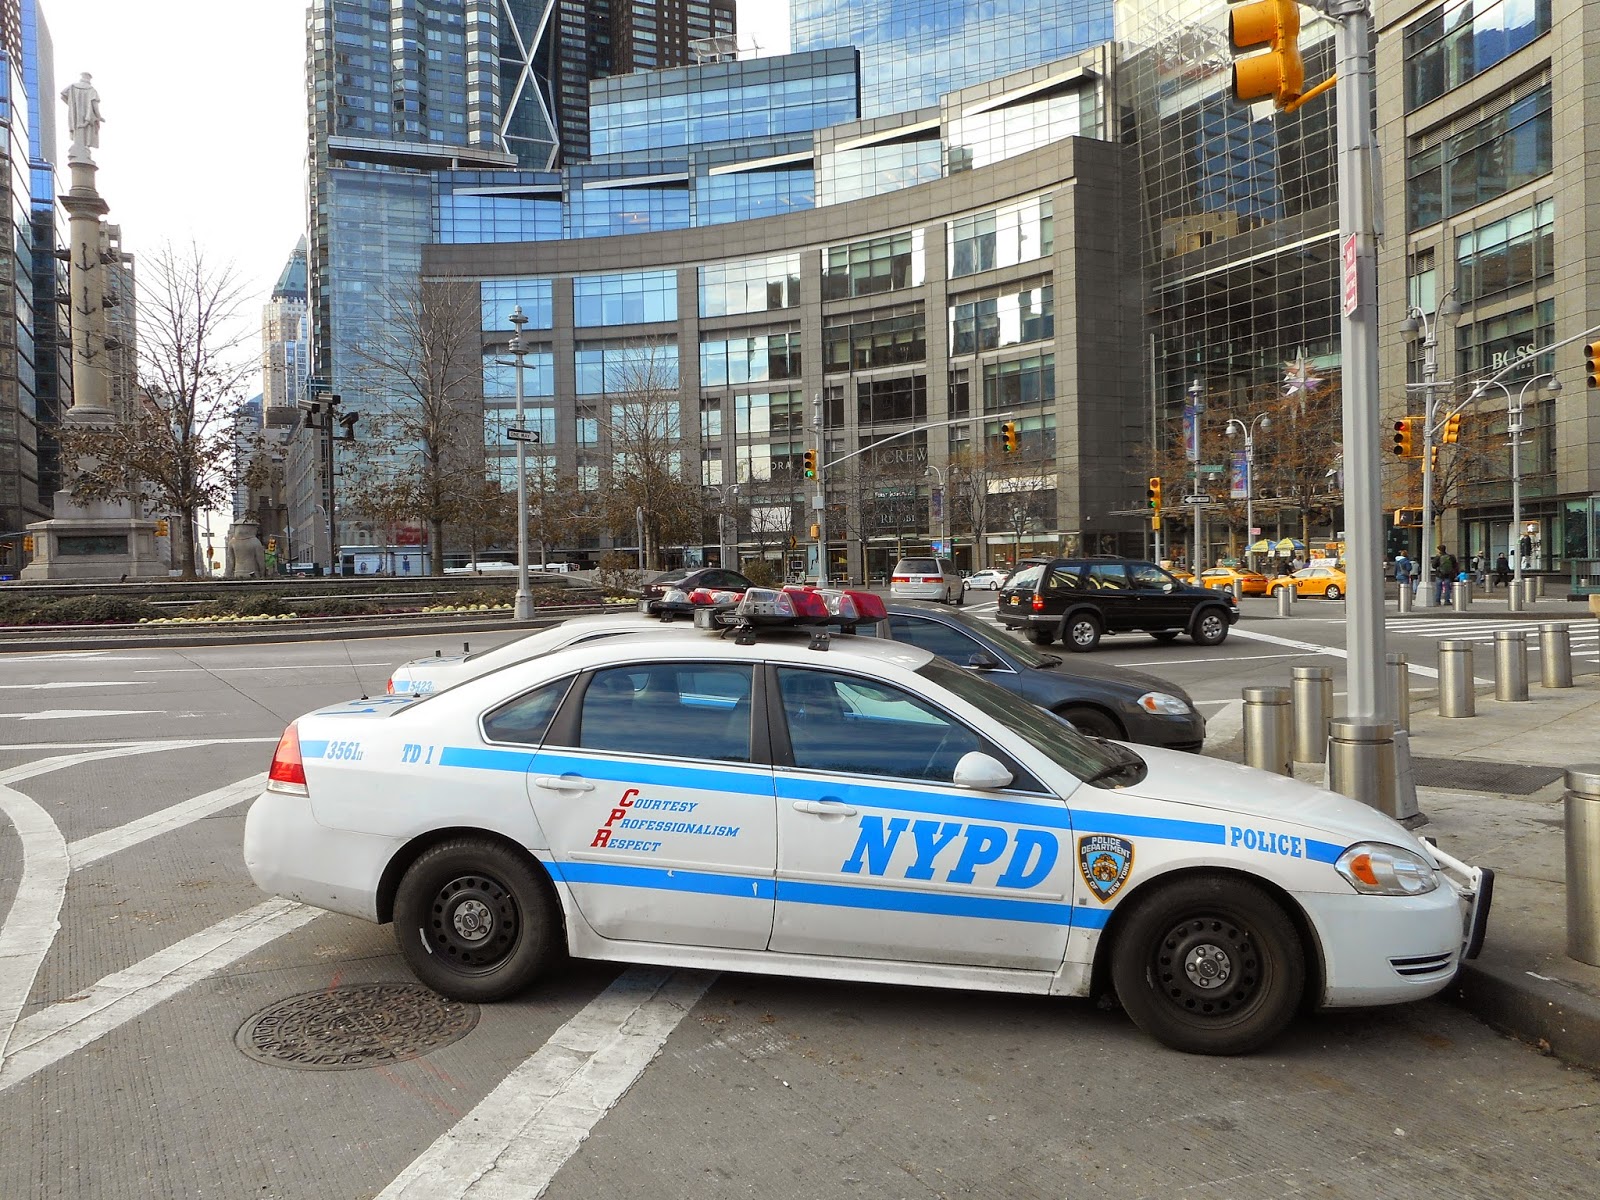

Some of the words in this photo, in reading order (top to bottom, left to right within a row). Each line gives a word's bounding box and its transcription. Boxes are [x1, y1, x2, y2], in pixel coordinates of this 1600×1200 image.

[402, 744, 422, 763] TD
[618, 788, 698, 812] COURTESY
[604, 808, 740, 837] PROFESSIONALISM
[590, 829, 662, 852] RESPECT
[841, 815, 1059, 889] NYPD
[1081, 843, 1131, 859] DEPARTMENT
[1091, 836, 1121, 847] POLICE
[1230, 826, 1302, 858] POLICE
[1081, 862, 1092, 879] CITY
[1089, 880, 1099, 890] OF
[1107, 880, 1121, 896] NEW
[1119, 861, 1131, 880] YORK
